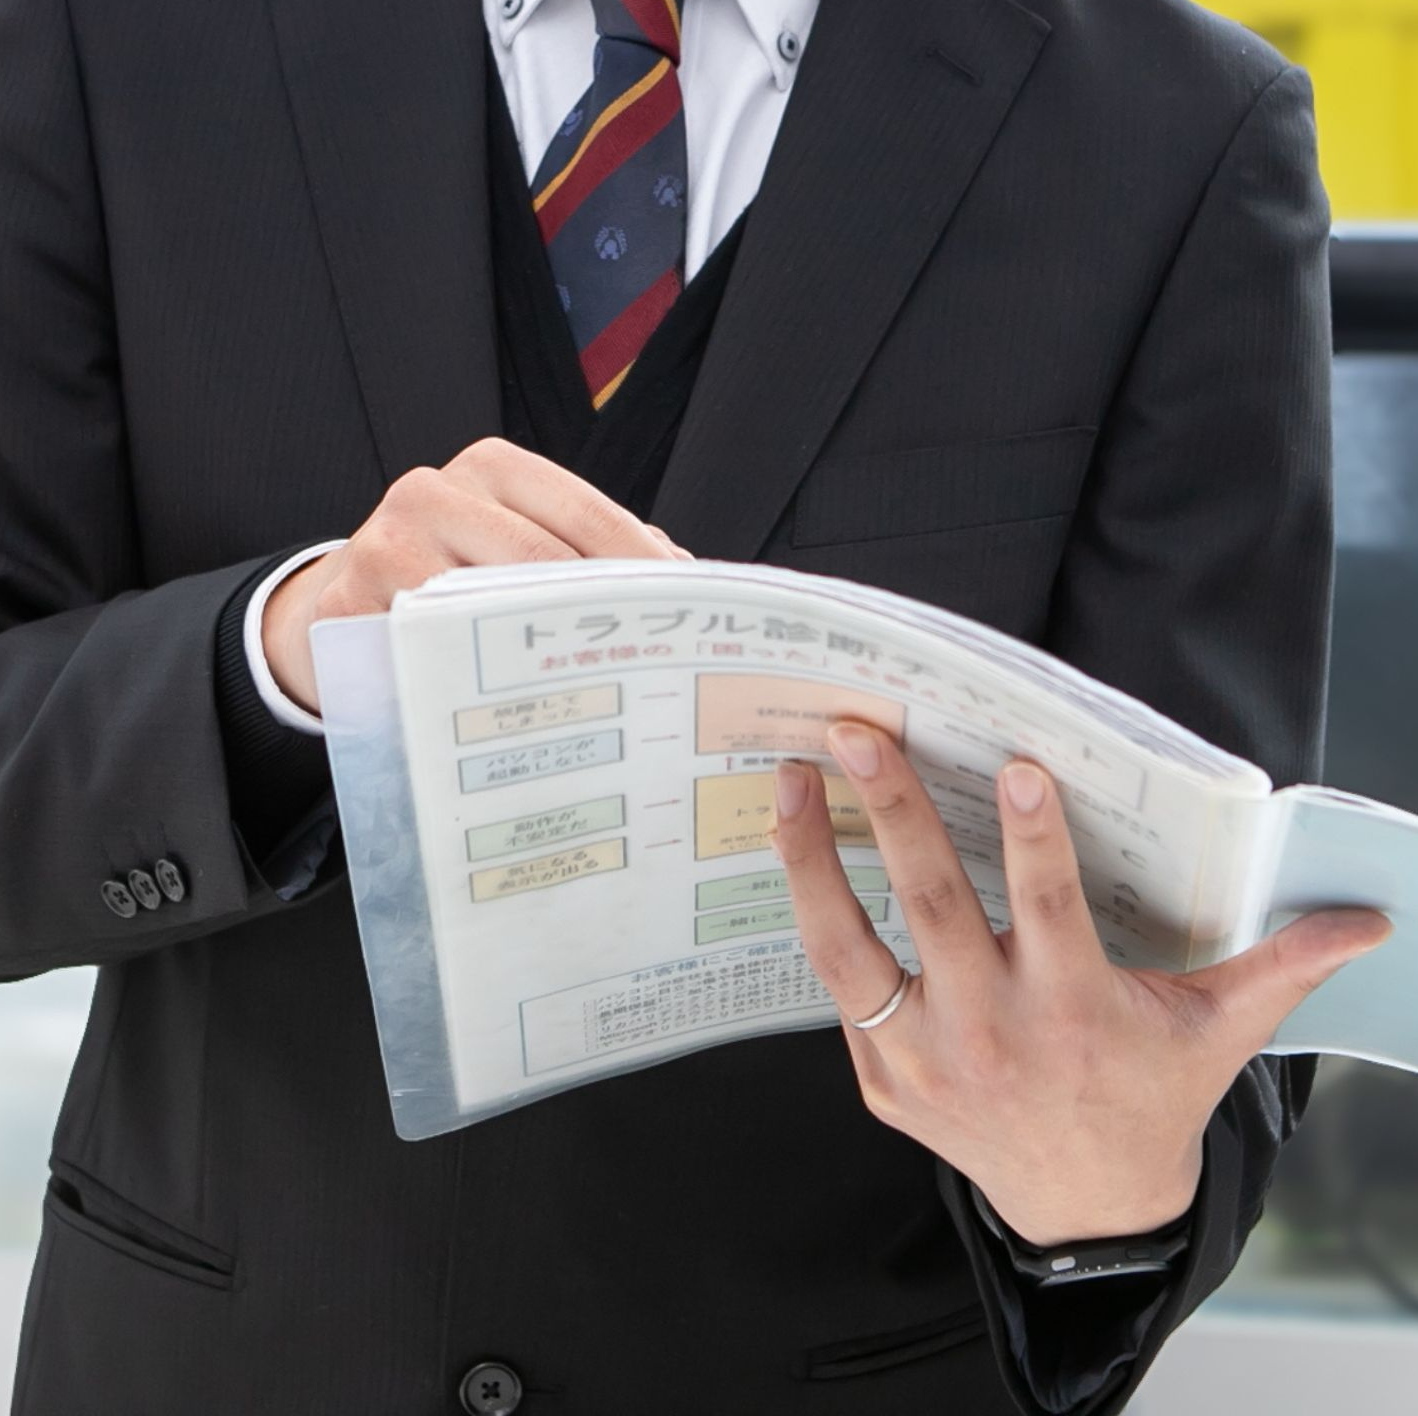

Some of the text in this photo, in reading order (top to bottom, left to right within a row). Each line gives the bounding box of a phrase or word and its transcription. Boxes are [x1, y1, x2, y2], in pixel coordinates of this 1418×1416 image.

[487, 737, 595, 769] パソコンが
